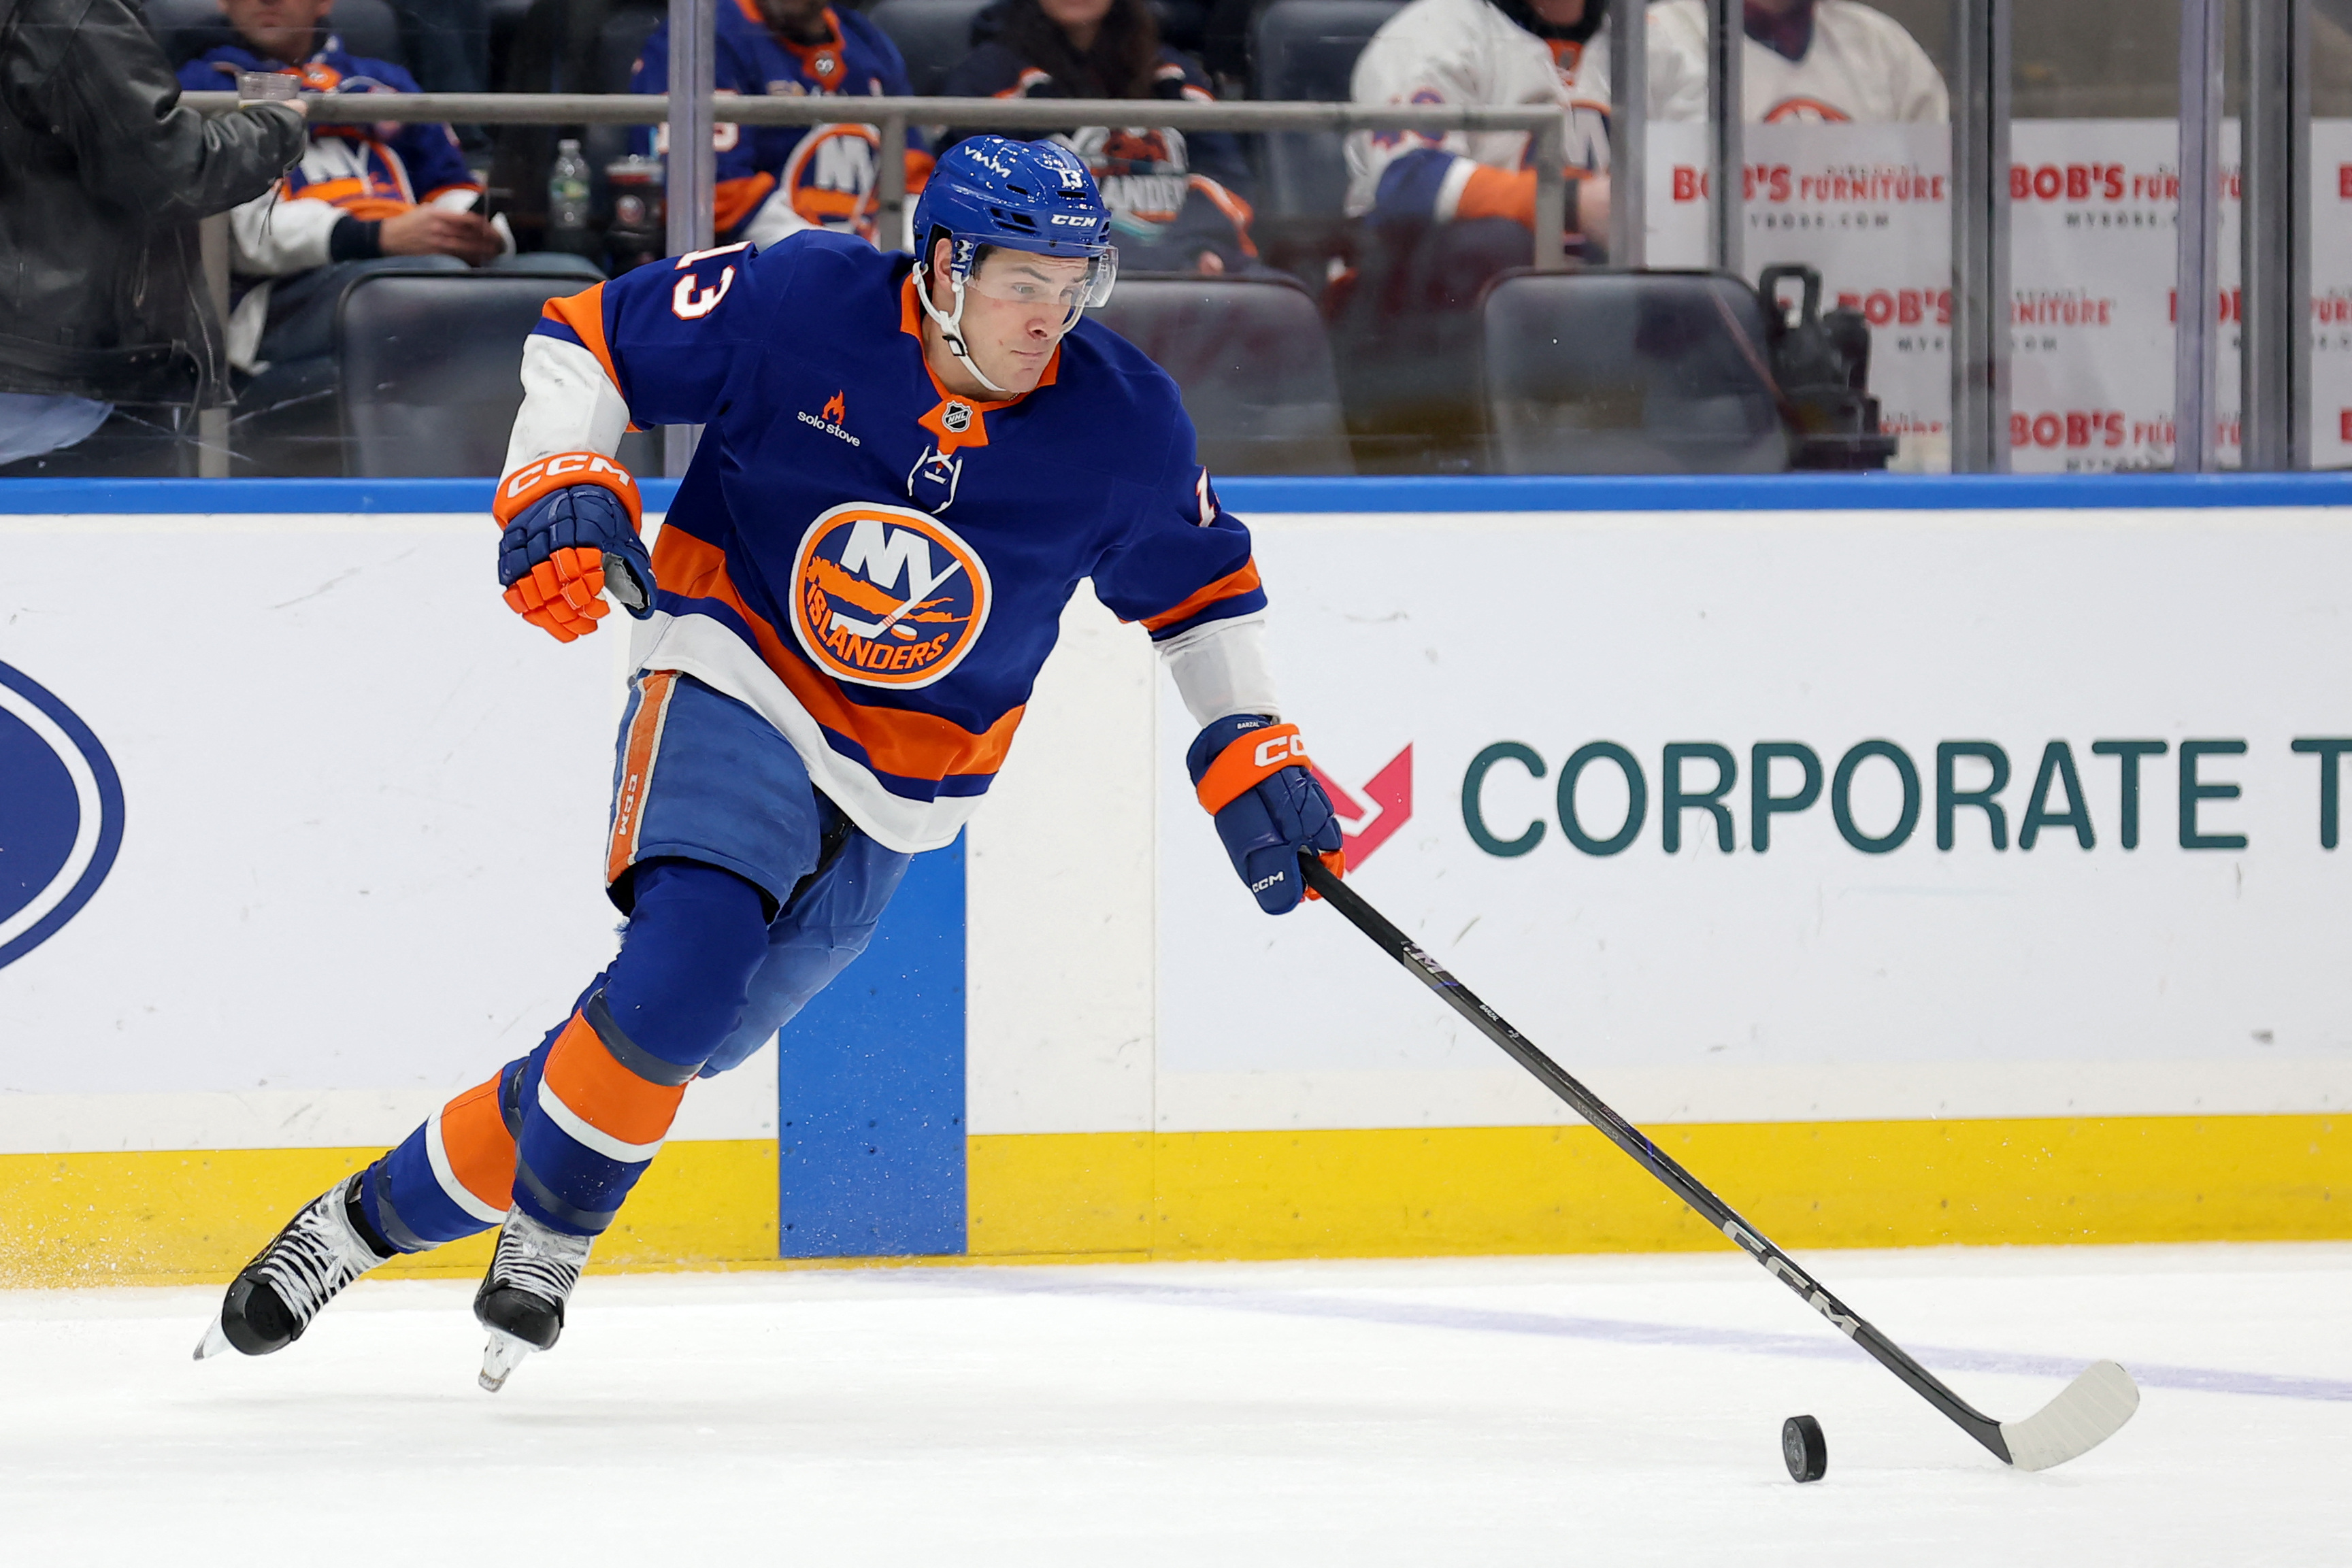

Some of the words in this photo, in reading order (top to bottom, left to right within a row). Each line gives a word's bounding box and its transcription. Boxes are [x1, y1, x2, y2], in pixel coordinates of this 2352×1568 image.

[1058, 169, 1084, 188] 13
[1800, 174, 1944, 202] FURNITURE
[2010, 163, 2125, 201] BOB'S
[1050, 214, 1098, 228] CCM
[672, 240, 754, 320] 13
[797, 411, 825, 430] solo
[825, 422, 861, 447] stove
[948, 409, 967, 424] NHL
[2010, 412, 2125, 447] BOB'S
[507, 454, 631, 499] CCM
[806, 583, 950, 670] ISLANDERS
[1236, 722, 1259, 730] BARZAL
[618, 773, 639, 835] CCM
[1461, 739, 2249, 858] CORPORATE
[1252, 871, 1284, 893] CCM
[1722, 1220, 1861, 1337] CCM
